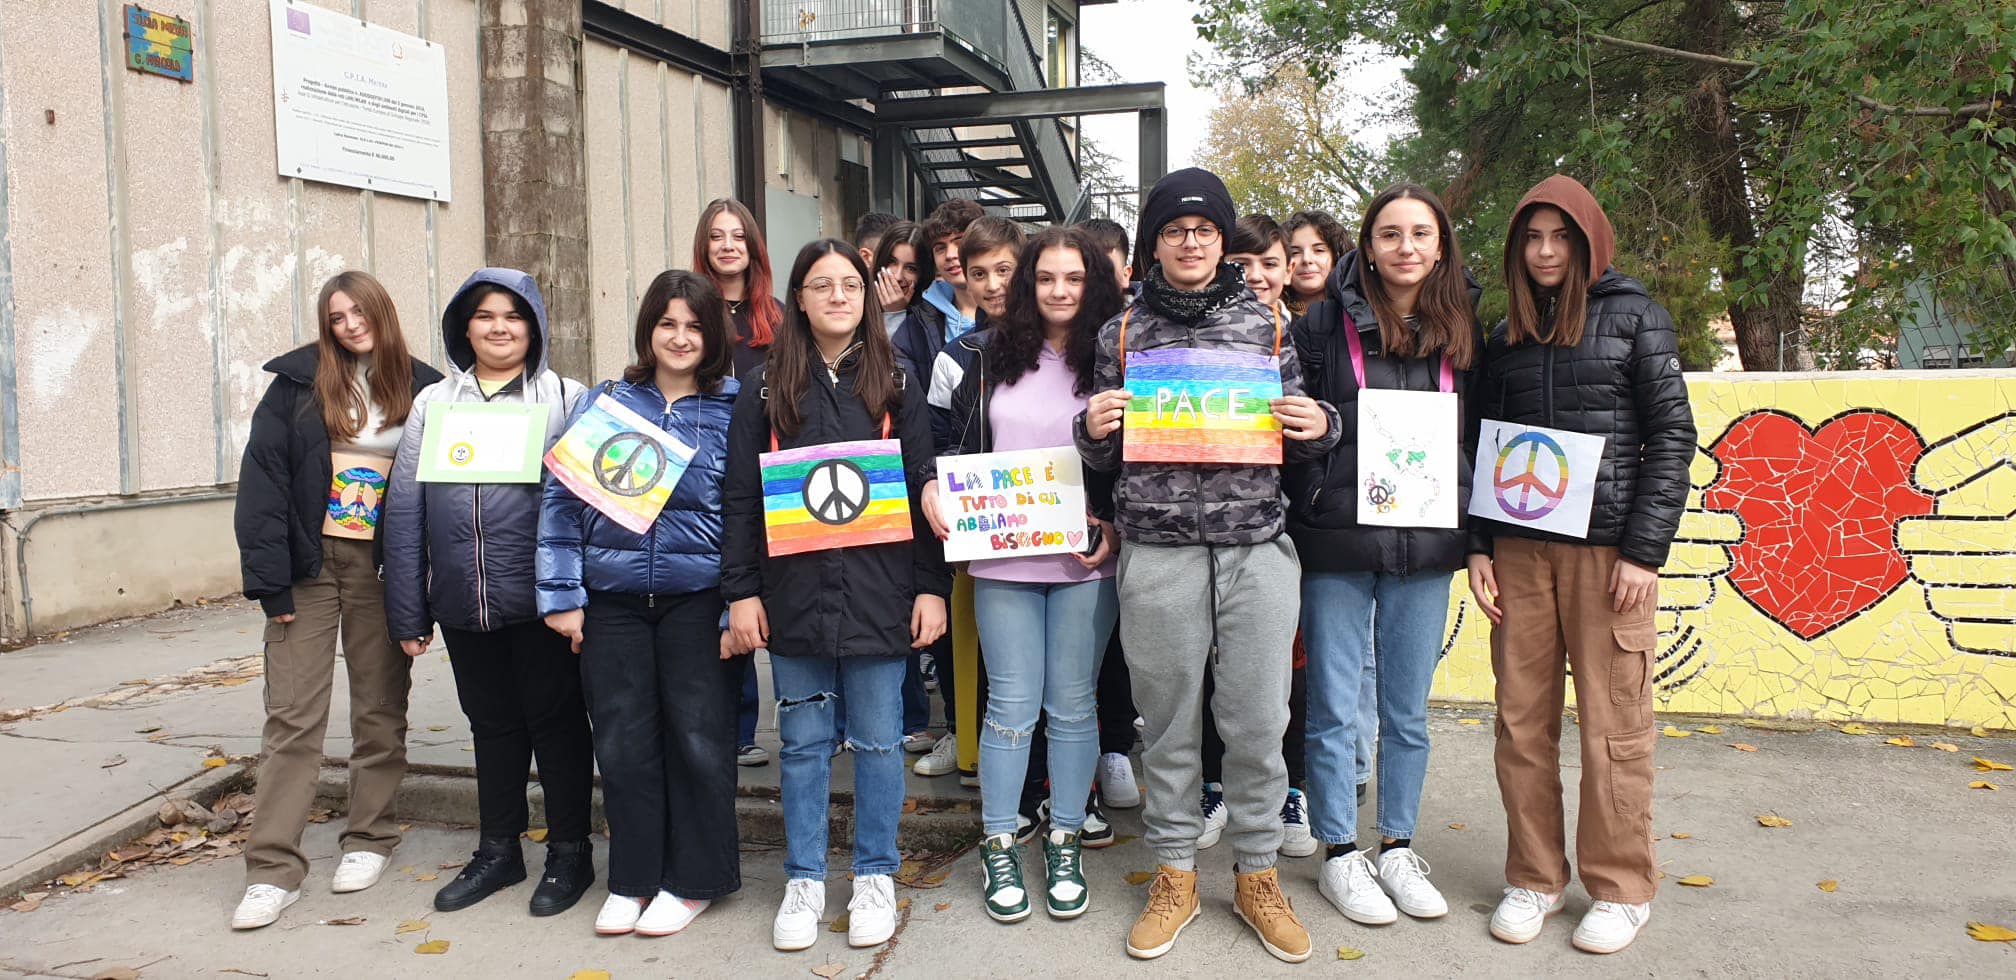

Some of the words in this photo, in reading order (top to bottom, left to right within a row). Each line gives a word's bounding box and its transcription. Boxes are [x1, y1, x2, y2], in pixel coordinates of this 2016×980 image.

[1156, 387, 1250, 420] PACE
[990, 466, 1034, 490] PACE
[1045, 460, 1055, 482] È
[959, 494, 1008, 513] TUTTO
